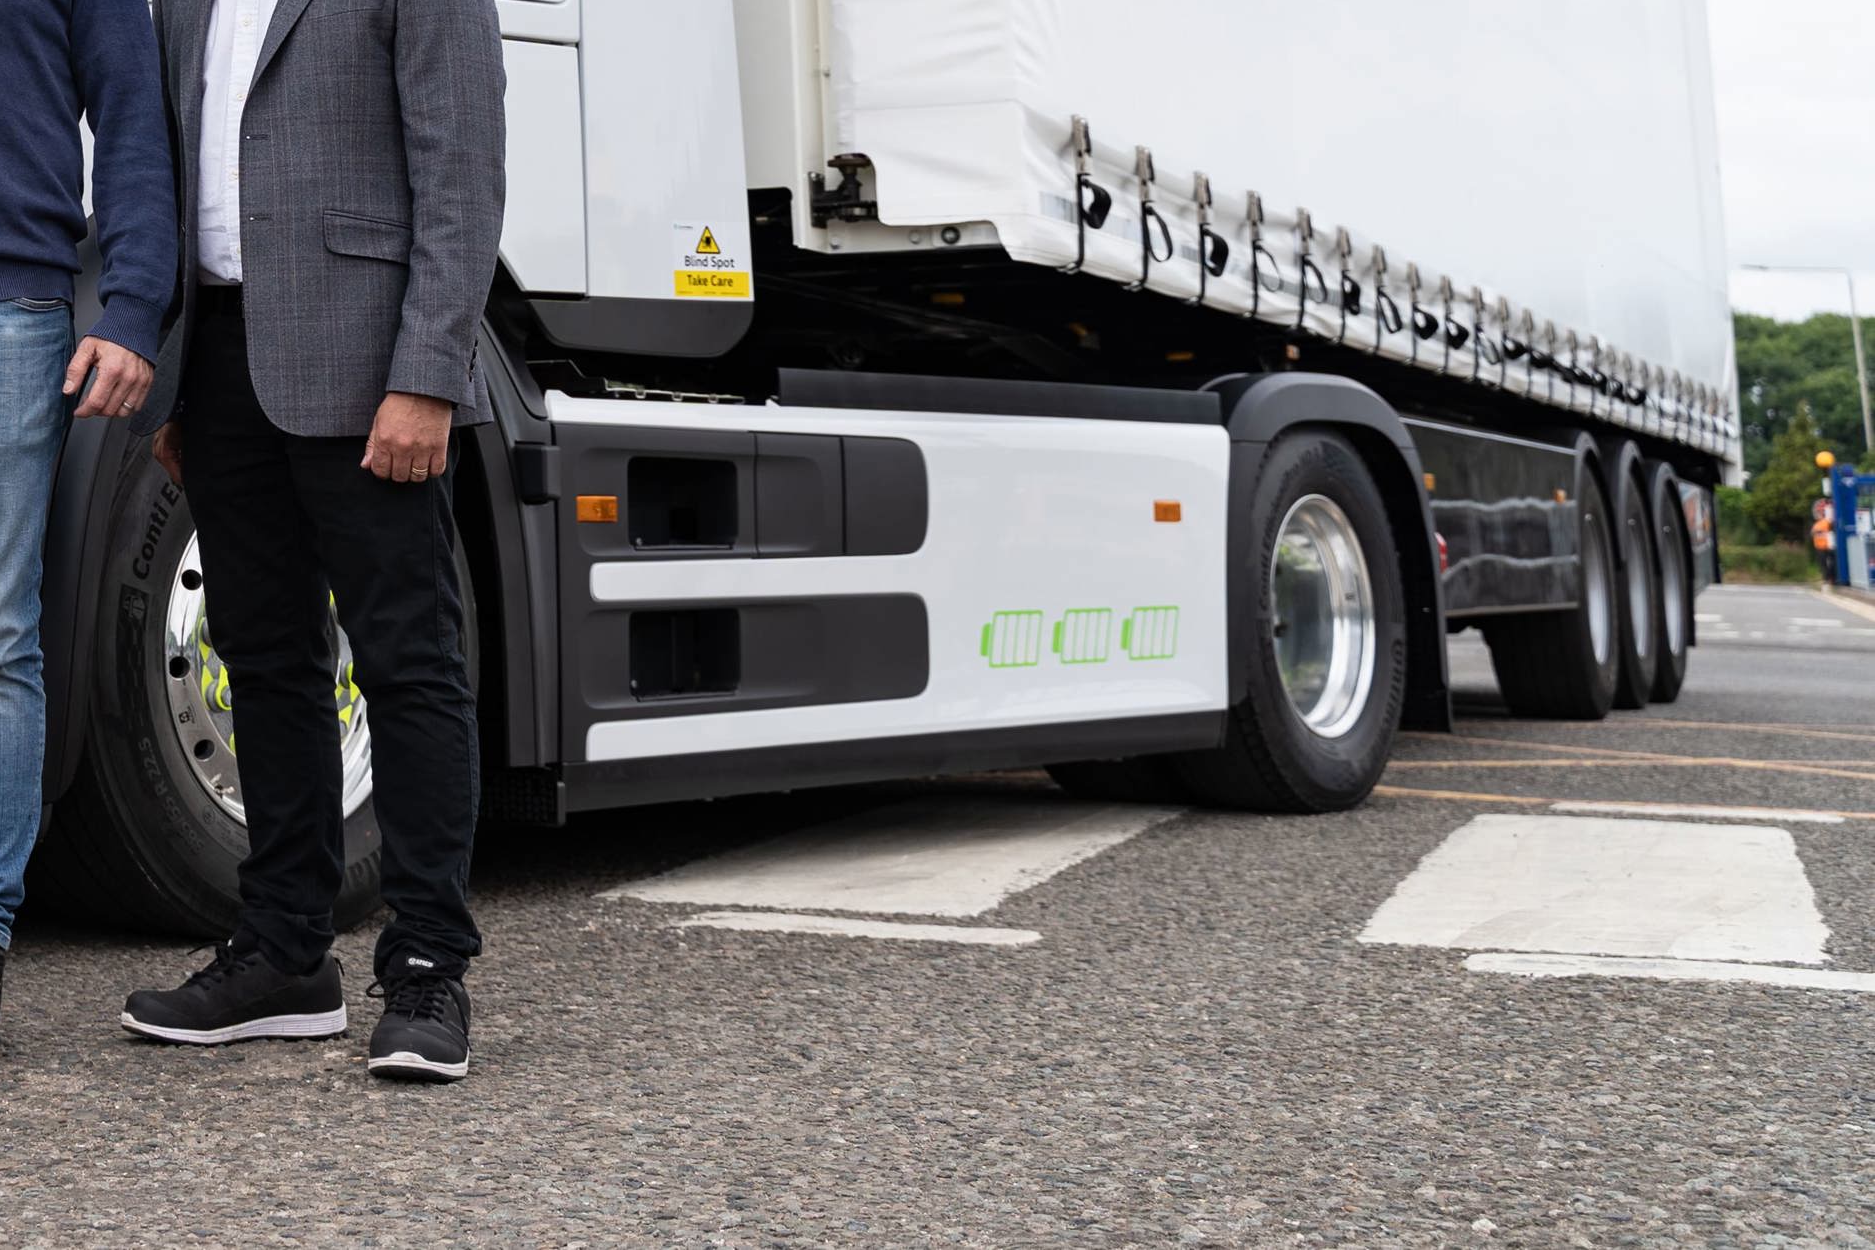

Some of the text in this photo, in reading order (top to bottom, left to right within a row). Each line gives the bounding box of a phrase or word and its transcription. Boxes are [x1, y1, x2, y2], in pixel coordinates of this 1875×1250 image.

[684, 255, 735, 269] Blind Spot
[686, 274, 734, 287] Take Care
[132, 501, 170, 581] Conti
